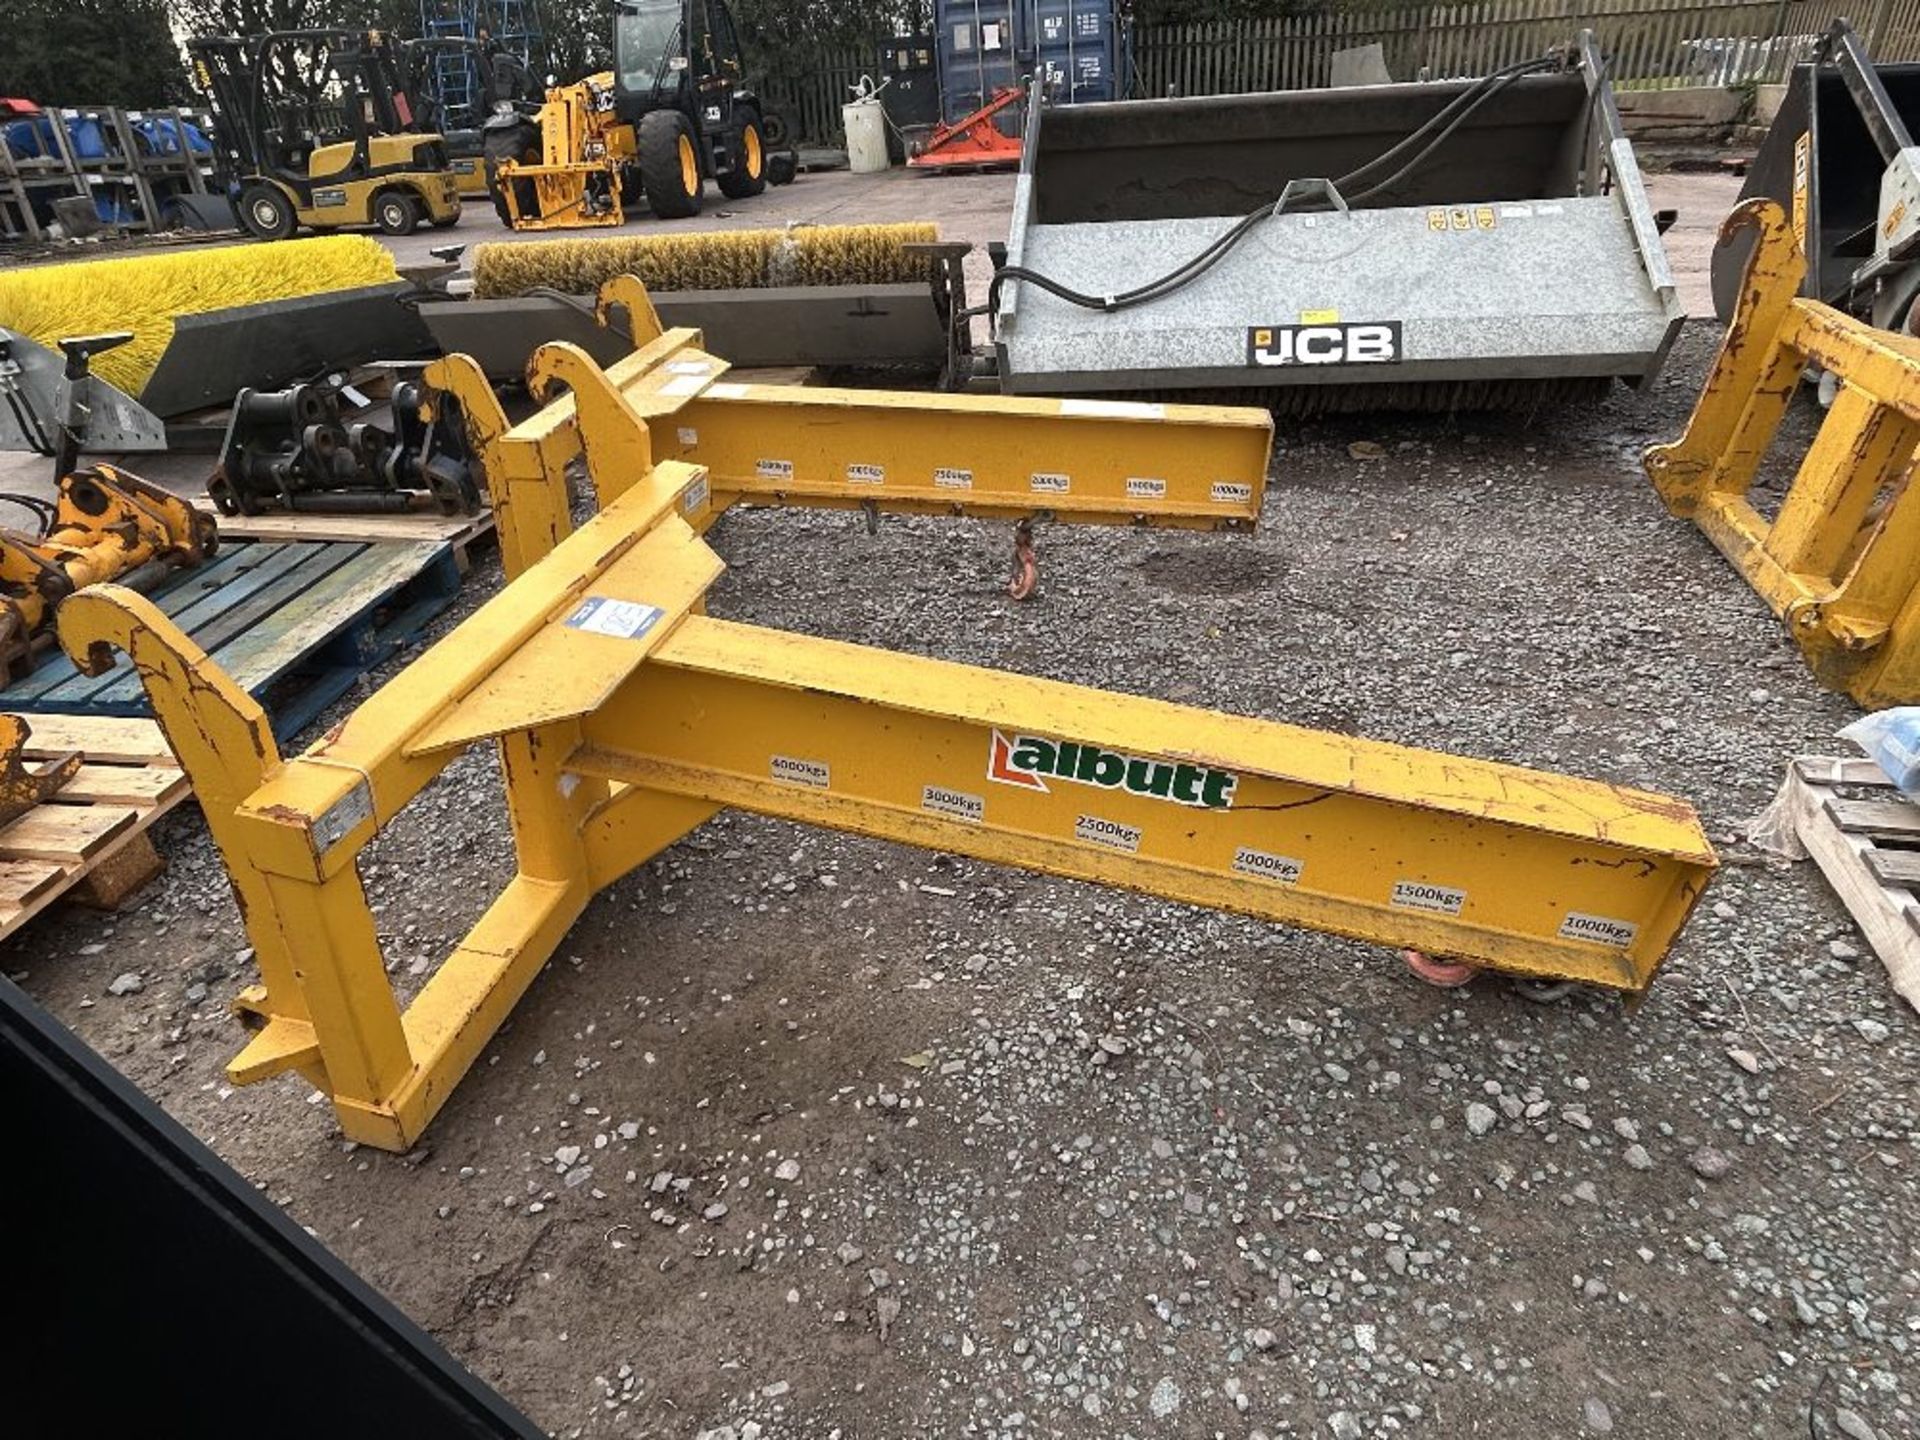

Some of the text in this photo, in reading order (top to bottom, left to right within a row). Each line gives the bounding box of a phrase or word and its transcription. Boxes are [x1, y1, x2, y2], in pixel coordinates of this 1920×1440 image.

[1254, 325, 1395, 366] JCB
[771, 758, 827, 777] 4000kgs
[1010, 734, 1238, 812] albutt
[925, 788, 982, 812] 3000kgs
[1075, 815, 1141, 842] 2500kgs
[1235, 852, 1298, 876] 2000kgs
[1395, 884, 1463, 905] 1500kgs
[1565, 917, 1632, 939] 1000kgs
